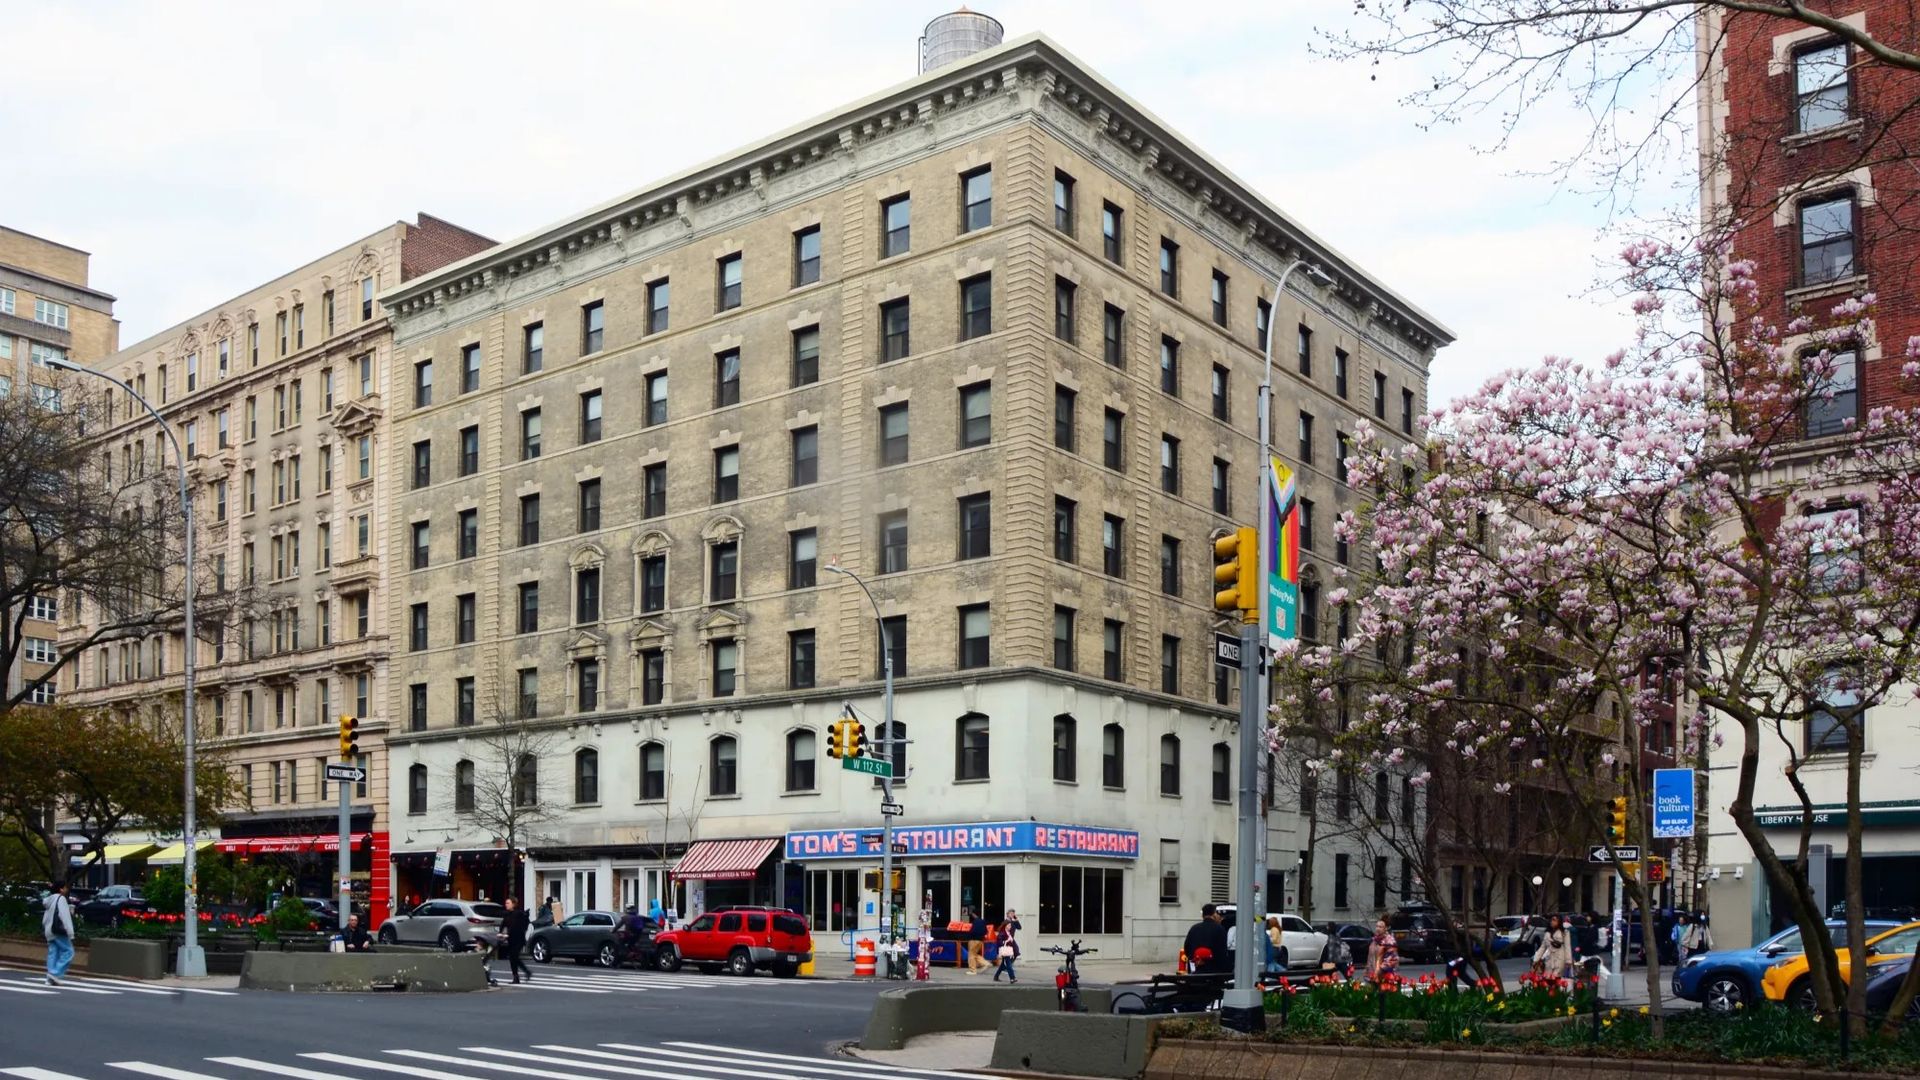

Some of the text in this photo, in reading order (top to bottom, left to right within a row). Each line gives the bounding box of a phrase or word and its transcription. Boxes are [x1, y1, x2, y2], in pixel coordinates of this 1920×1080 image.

[1222, 644, 1239, 660] ONE
[853, 758, 883, 774] W 112 St
[332, 769, 344, 777] ONE
[1658, 795, 1681, 804] book
[1658, 804, 1690, 813] culture
[1760, 814, 1829, 825] LIBERTY HUSE
[789, 831, 857, 854] TOM'S
[1035, 826, 1138, 853] RESTAURANT
